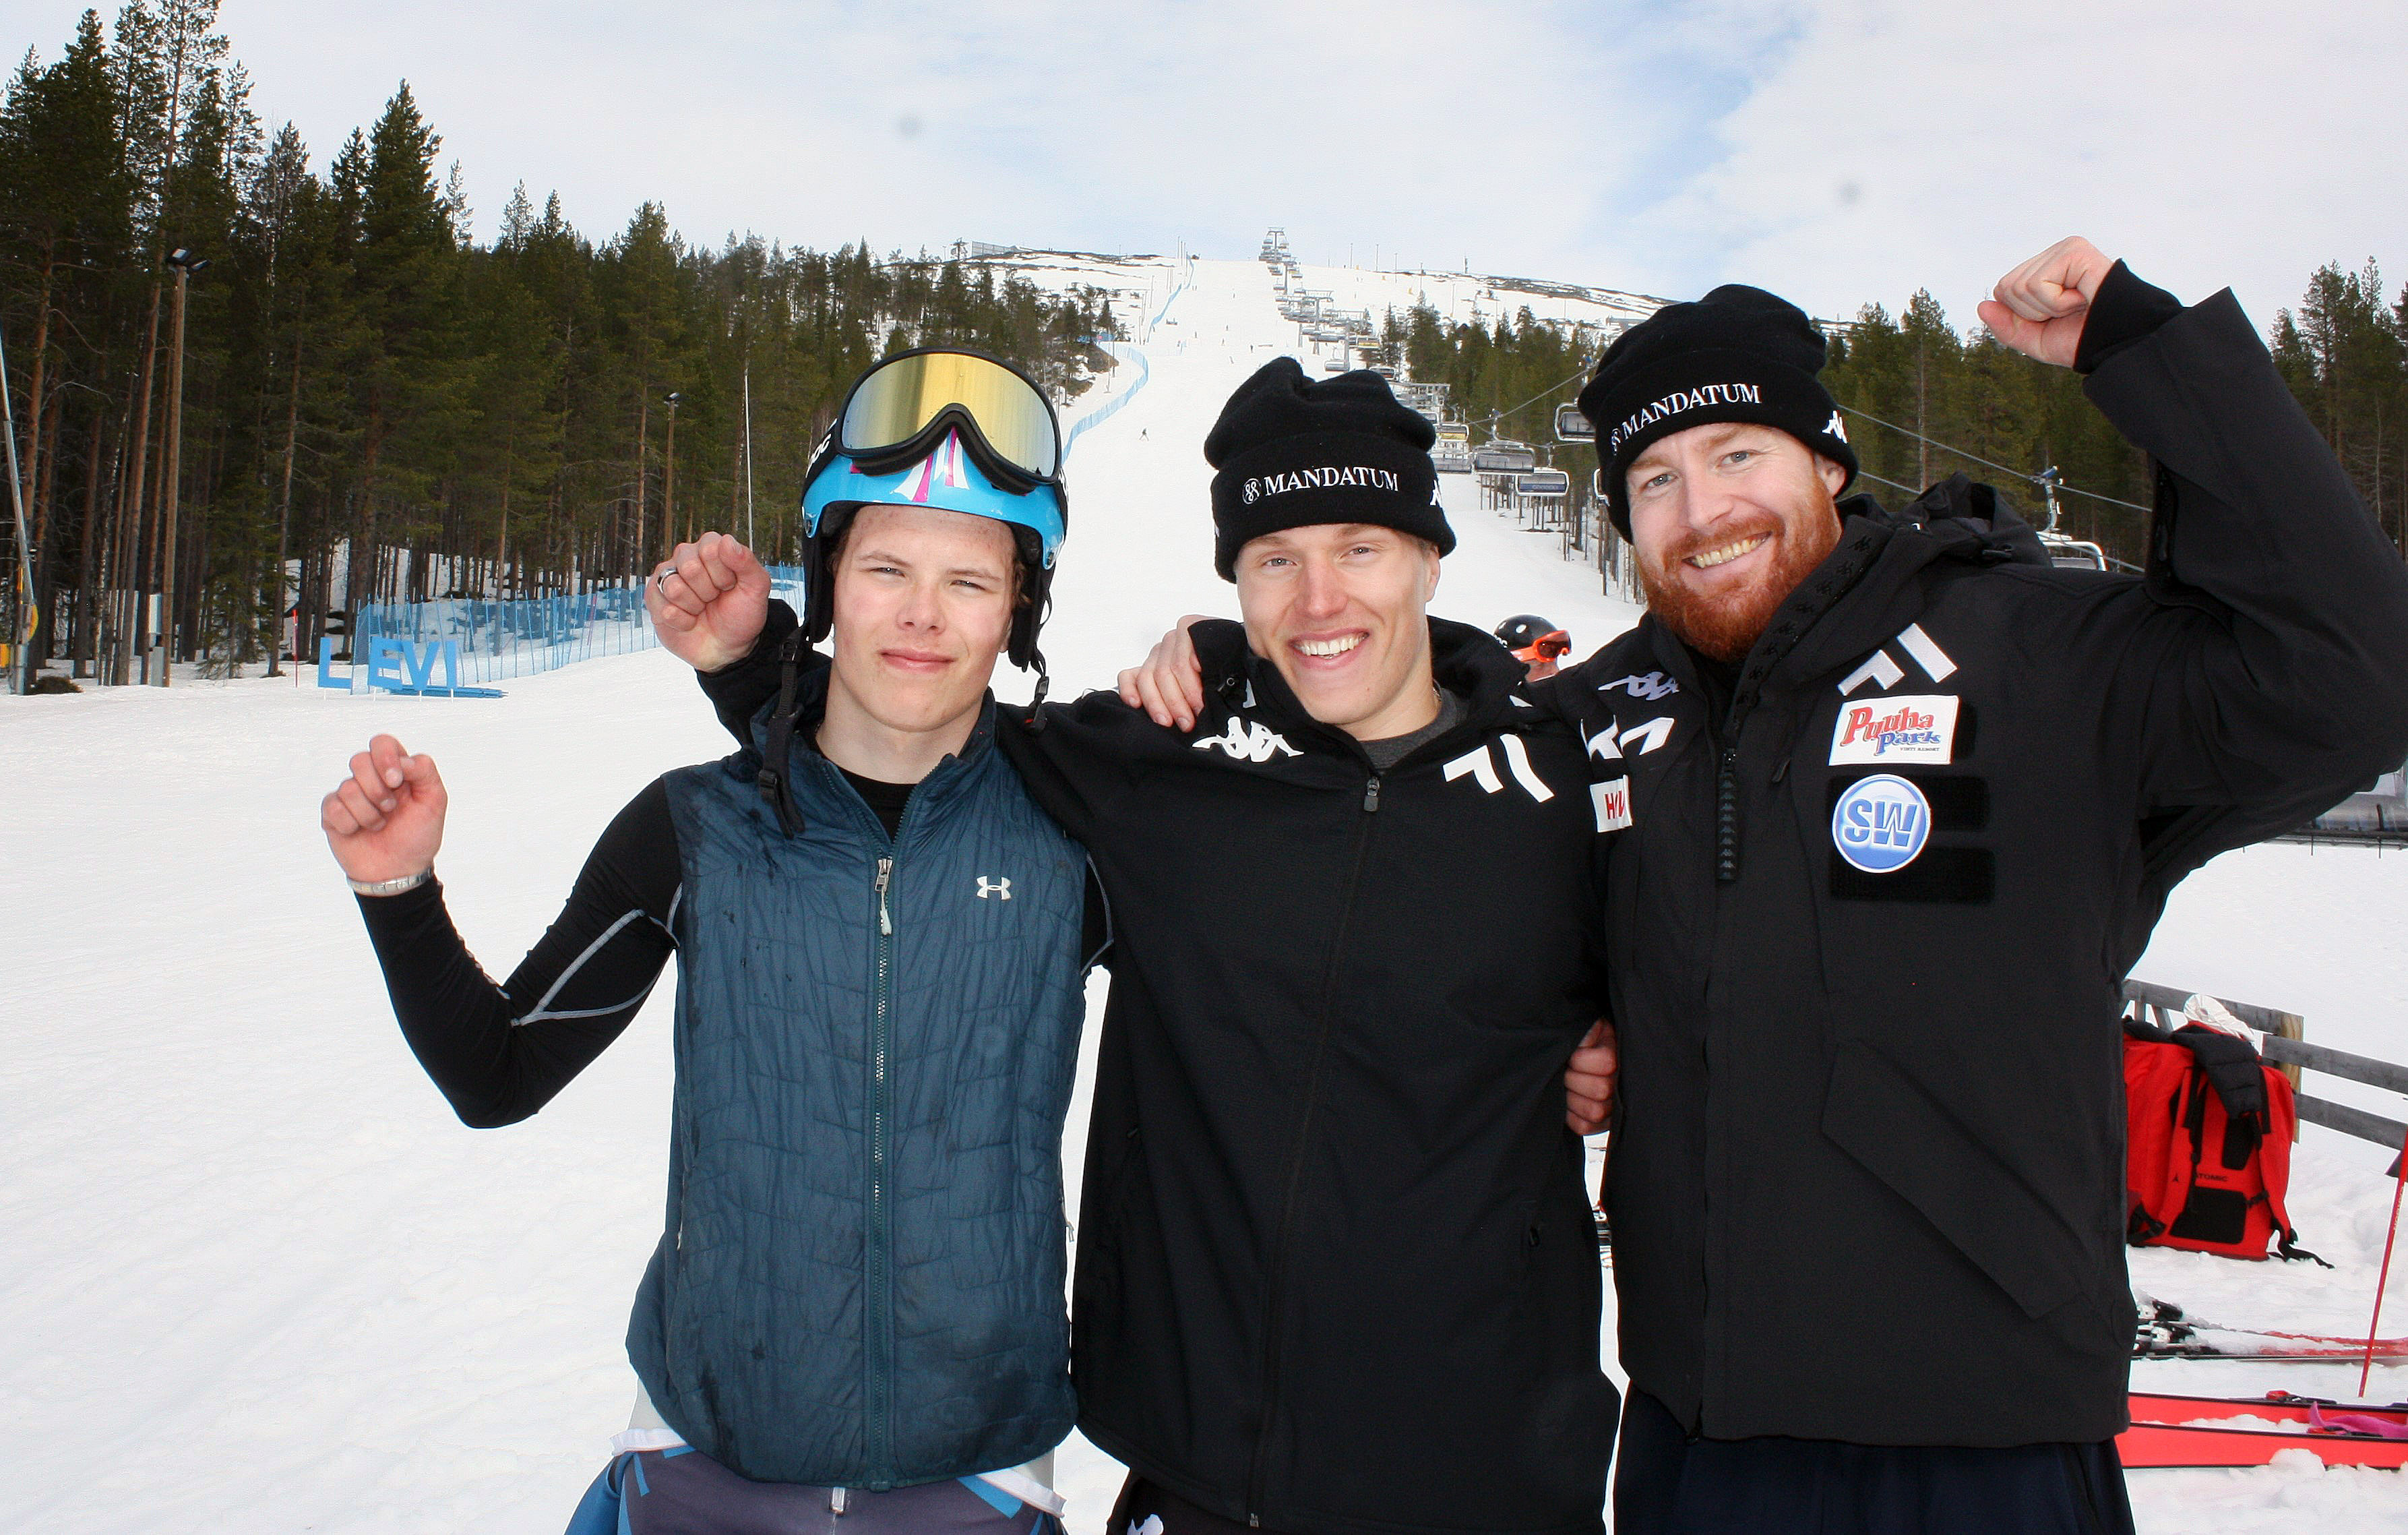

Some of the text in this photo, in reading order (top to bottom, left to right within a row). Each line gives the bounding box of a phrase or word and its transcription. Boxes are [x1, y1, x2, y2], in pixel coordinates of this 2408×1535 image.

[1621, 383, 1762, 441] MANDATUM
[1263, 466, 1400, 497] MANDATUM
[317, 636, 458, 692] LEVI
[1840, 706, 1934, 747] Puuha
[1843, 798, 1918, 847] SW
